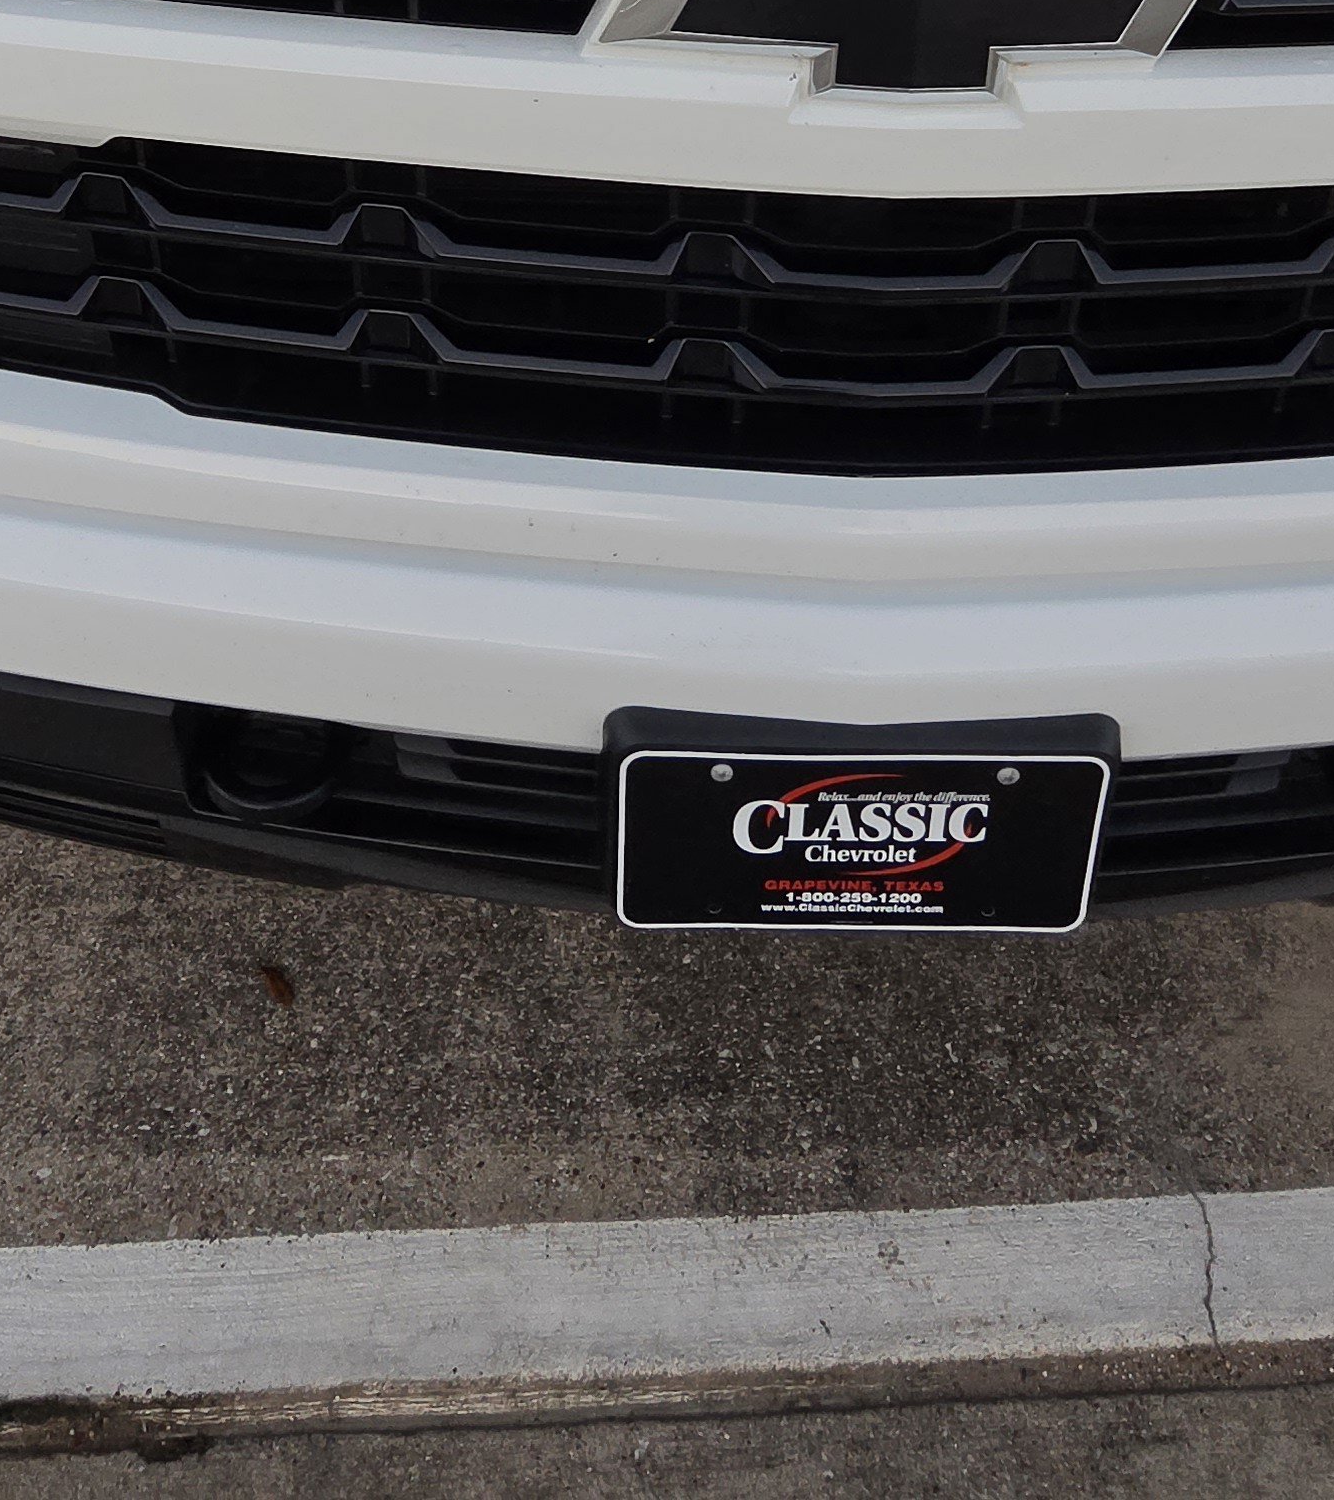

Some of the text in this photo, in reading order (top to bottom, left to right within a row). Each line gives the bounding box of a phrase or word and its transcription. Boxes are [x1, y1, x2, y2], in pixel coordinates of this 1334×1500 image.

[882, 793, 913, 804] enjoy
[914, 792, 930, 802] the
[733, 800, 989, 854] CLASSIC
[805, 845, 917, 863] Chevrolet
[764, 880, 944, 892] GRAPEVINE, TEXAS
[786, 892, 922, 904] 1-800-259-1200
[761, 903, 944, 914] www.ClassicChevrolet.com
